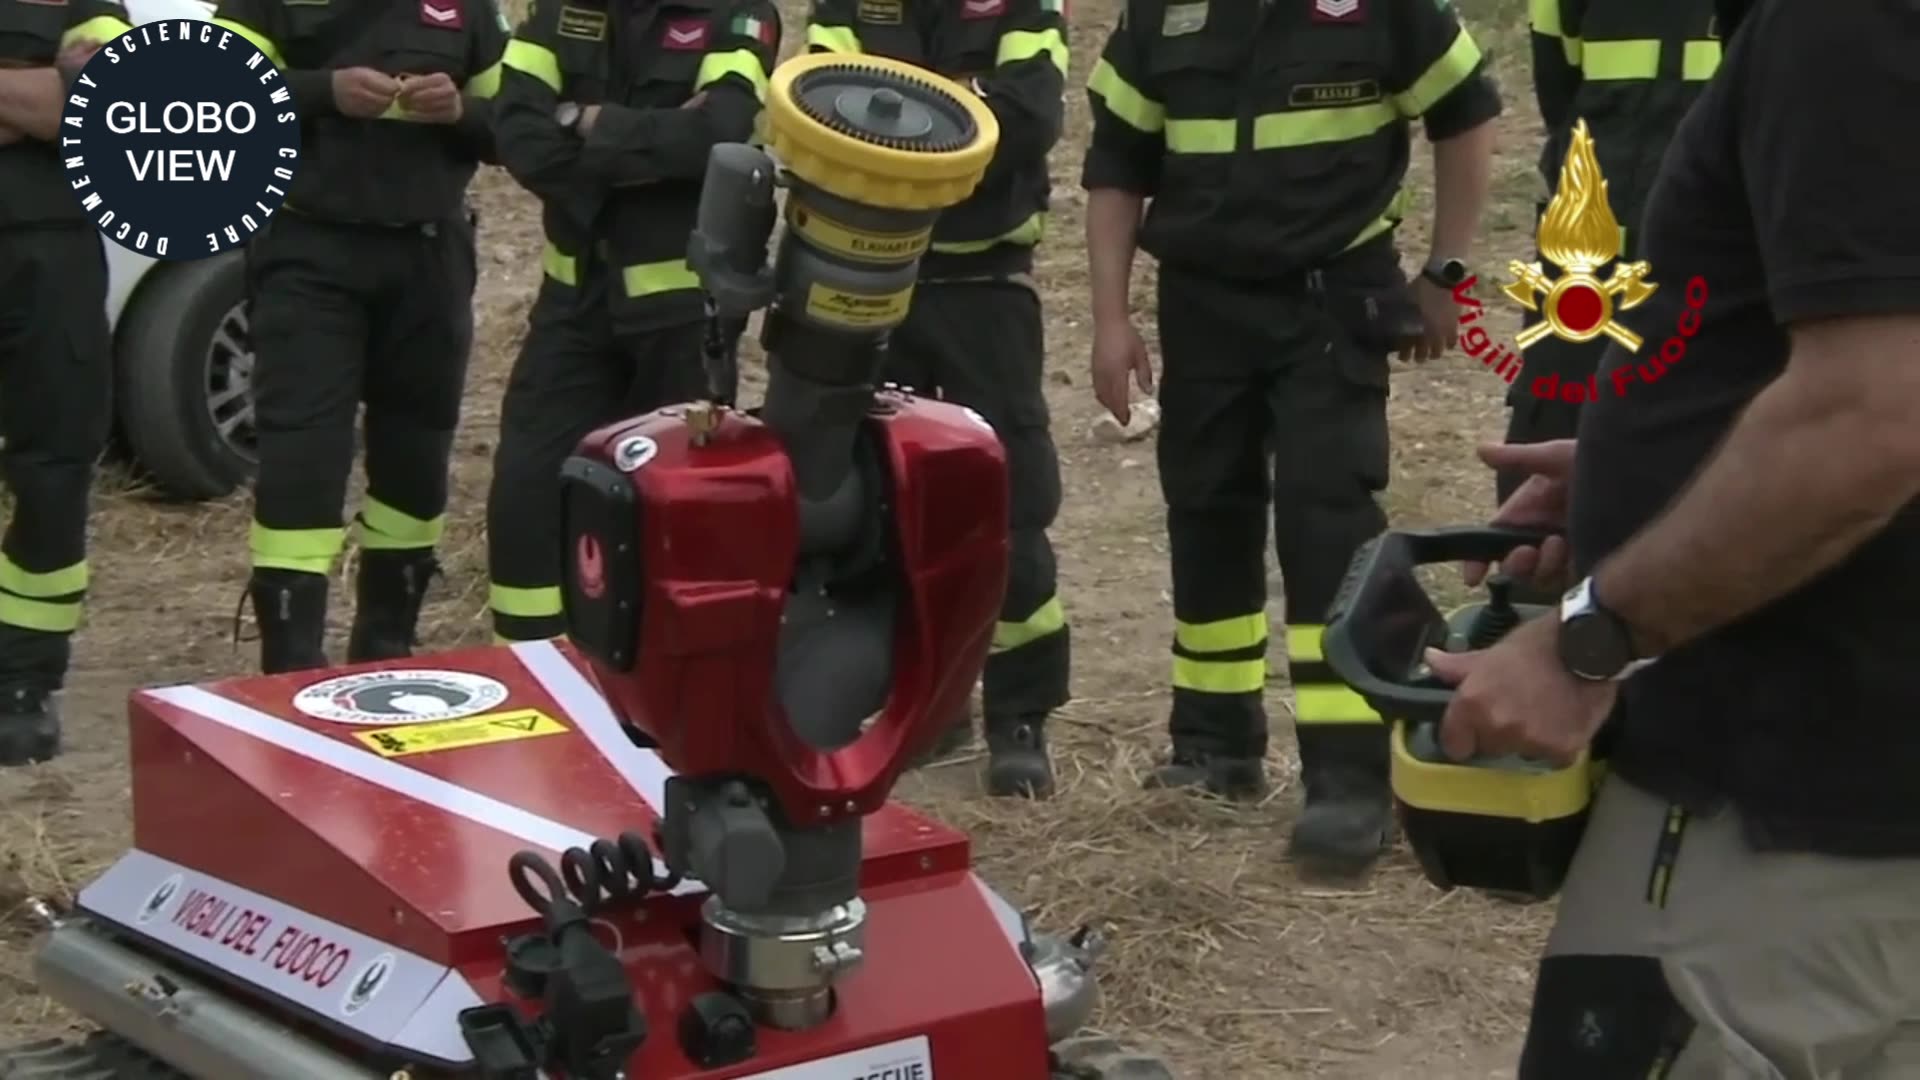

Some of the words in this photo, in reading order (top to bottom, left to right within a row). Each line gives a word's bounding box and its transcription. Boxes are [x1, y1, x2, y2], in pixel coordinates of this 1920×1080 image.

[171, 888, 237, 940] VIGILI
[219, 908, 272, 956] DEL
[261, 926, 351, 989] FUOCO
